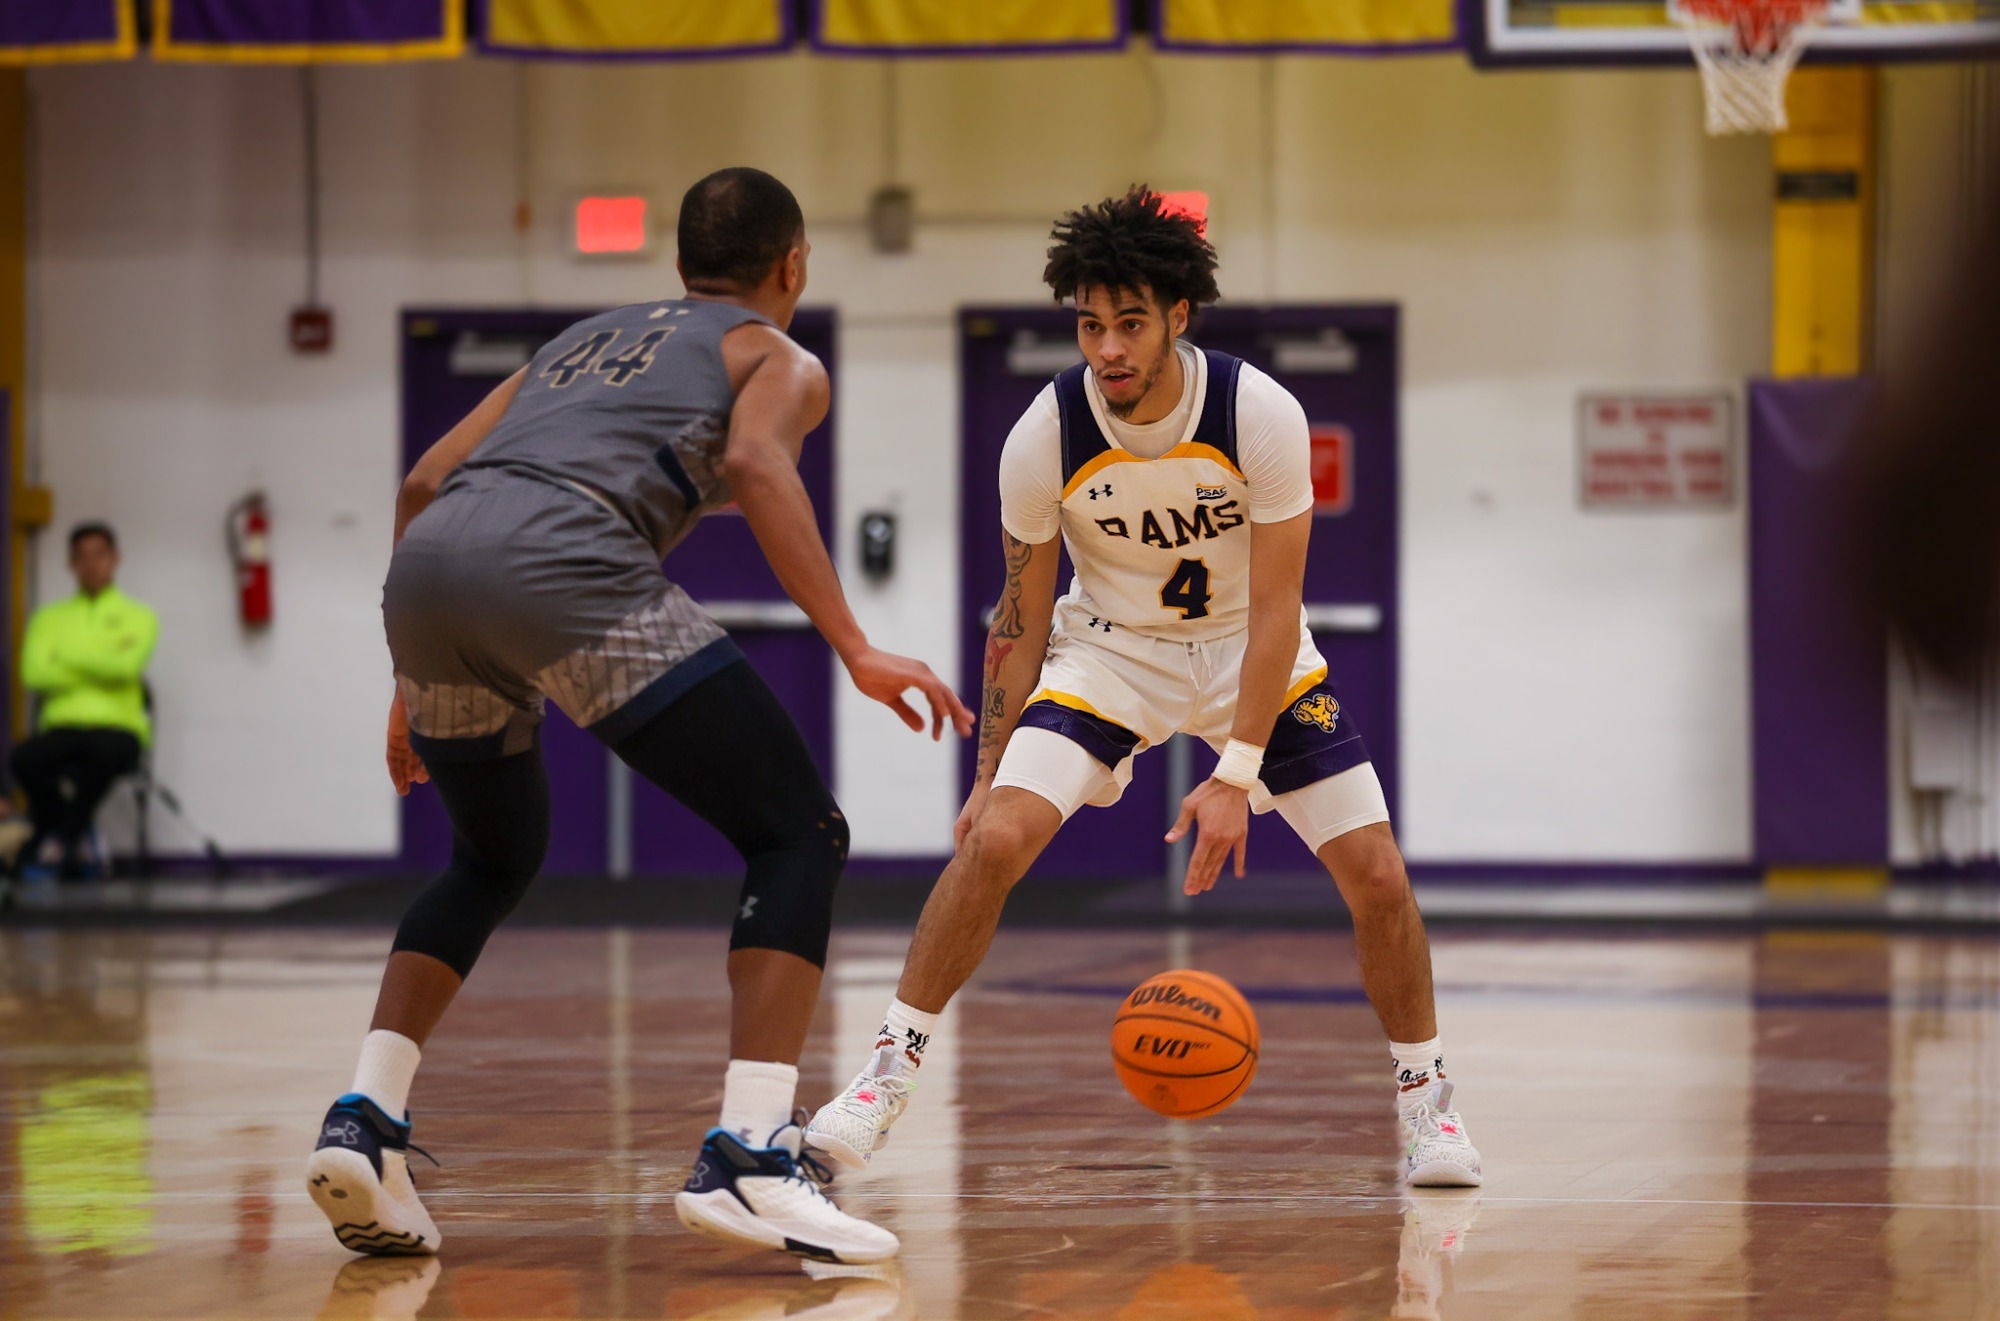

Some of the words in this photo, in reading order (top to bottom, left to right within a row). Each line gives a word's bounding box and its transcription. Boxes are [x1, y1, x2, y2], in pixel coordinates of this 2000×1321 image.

[538, 326, 677, 388] 44
[1158, 556, 1214, 620] 4
[1130, 984, 1222, 1021] Wilson
[1133, 1033, 1192, 1060] EVO
